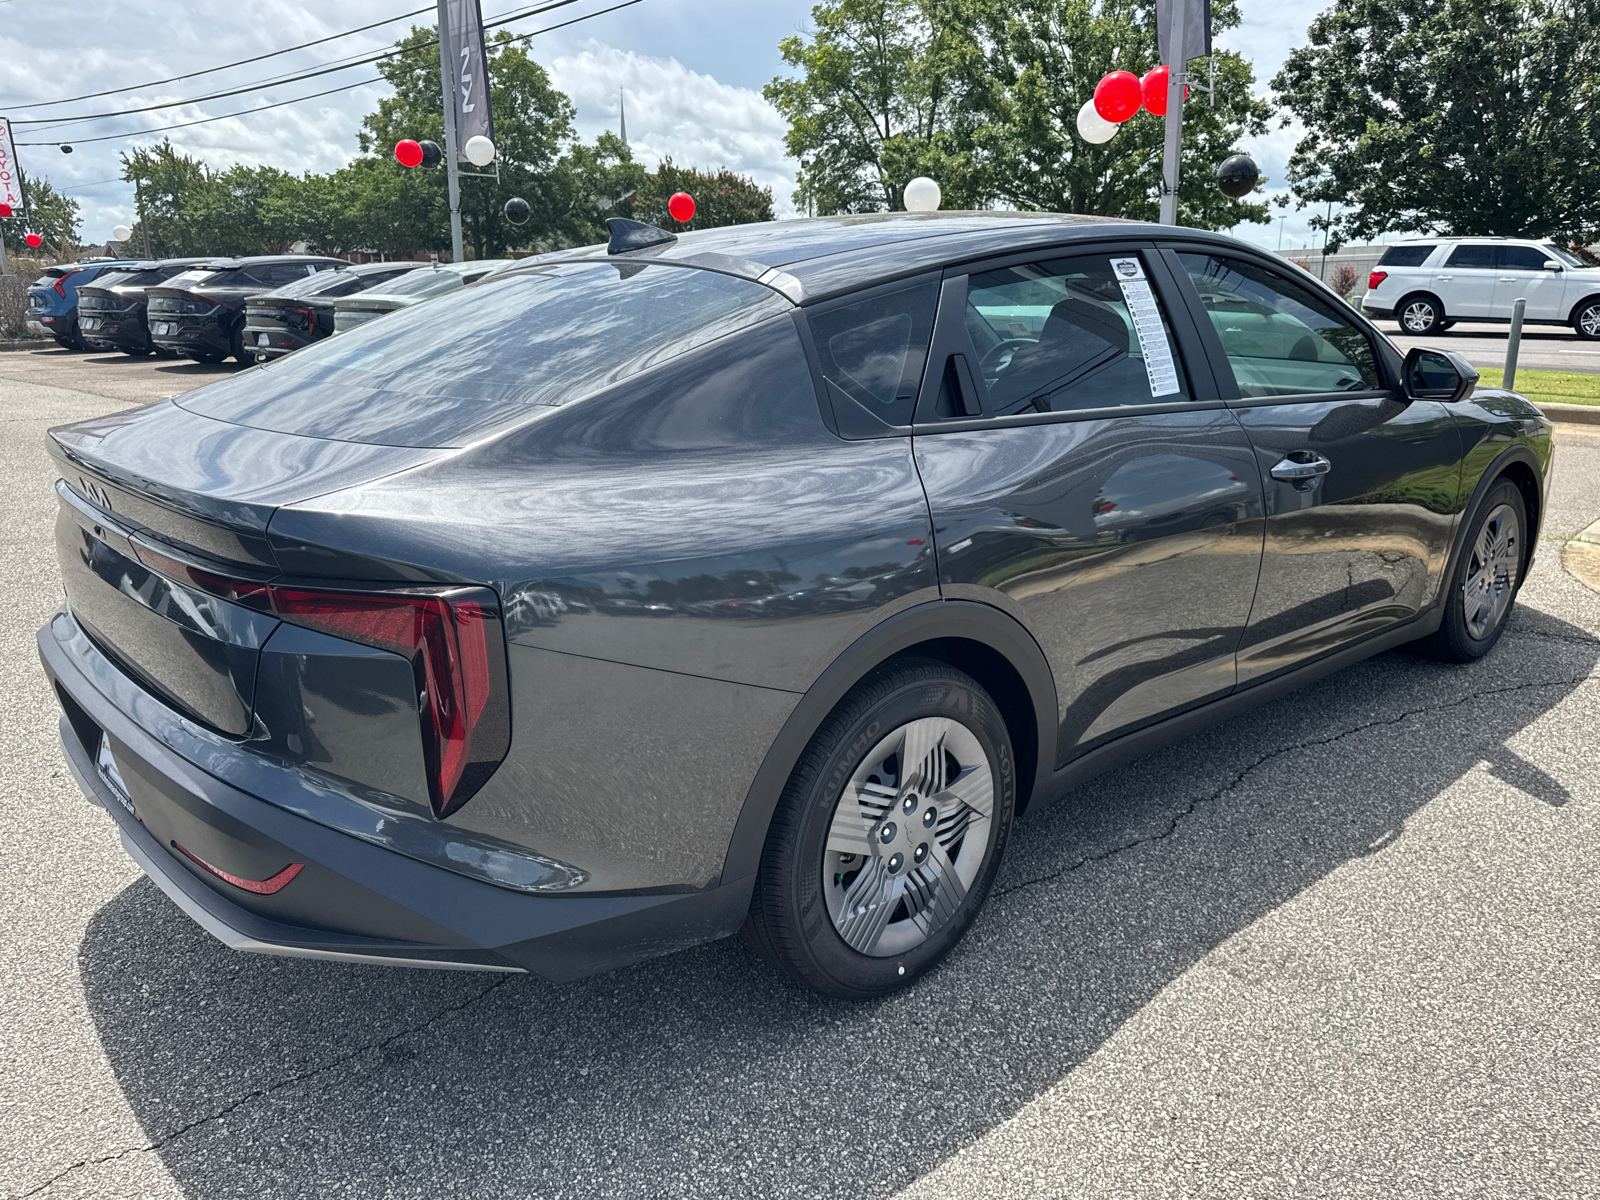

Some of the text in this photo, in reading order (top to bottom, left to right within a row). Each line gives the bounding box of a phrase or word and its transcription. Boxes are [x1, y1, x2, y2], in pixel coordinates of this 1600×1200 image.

[0, 138, 16, 203] OYOTA
[820, 721, 880, 809] KUMHO
[998, 743, 1012, 824] SOLUS
